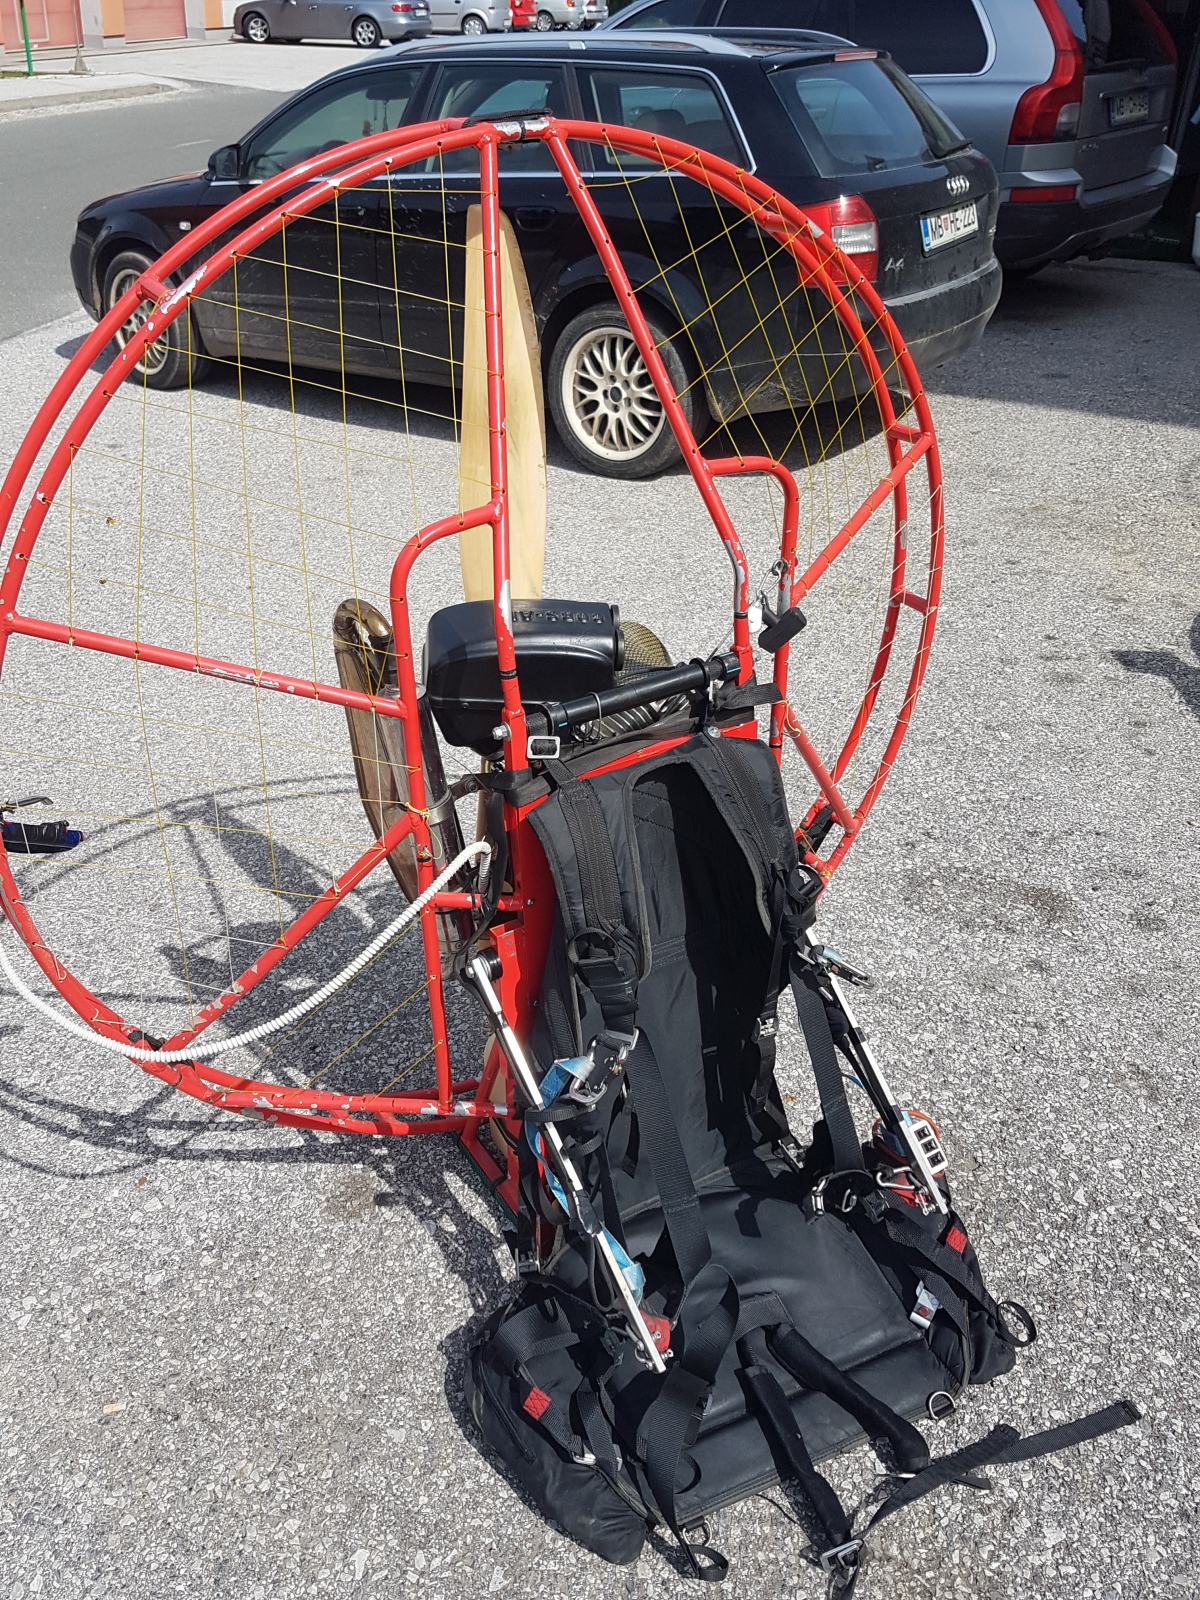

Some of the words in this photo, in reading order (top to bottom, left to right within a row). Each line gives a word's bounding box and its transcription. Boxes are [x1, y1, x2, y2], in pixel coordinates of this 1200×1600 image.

[929, 215, 944, 242] MB
[949, 202, 976, 234] HE-223
[884, 257, 905, 272] A4
